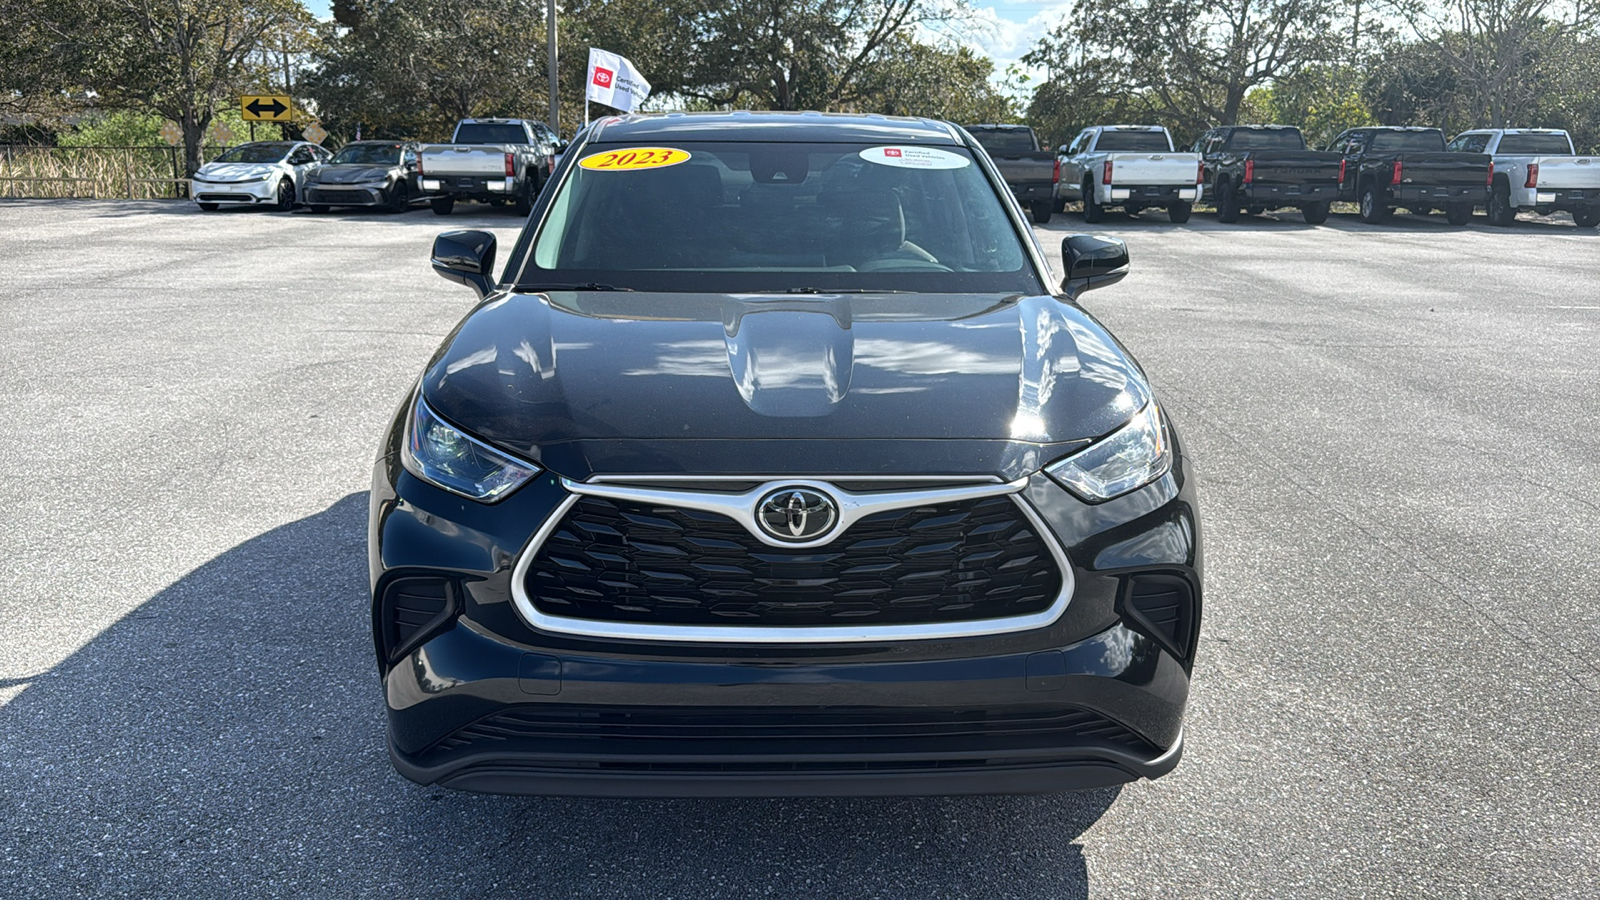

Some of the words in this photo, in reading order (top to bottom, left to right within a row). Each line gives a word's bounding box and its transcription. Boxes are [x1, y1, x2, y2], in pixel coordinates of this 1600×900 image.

[615, 83, 629, 92] Used
[616, 76, 639, 89] Certified
[597, 151, 673, 167] 2023
